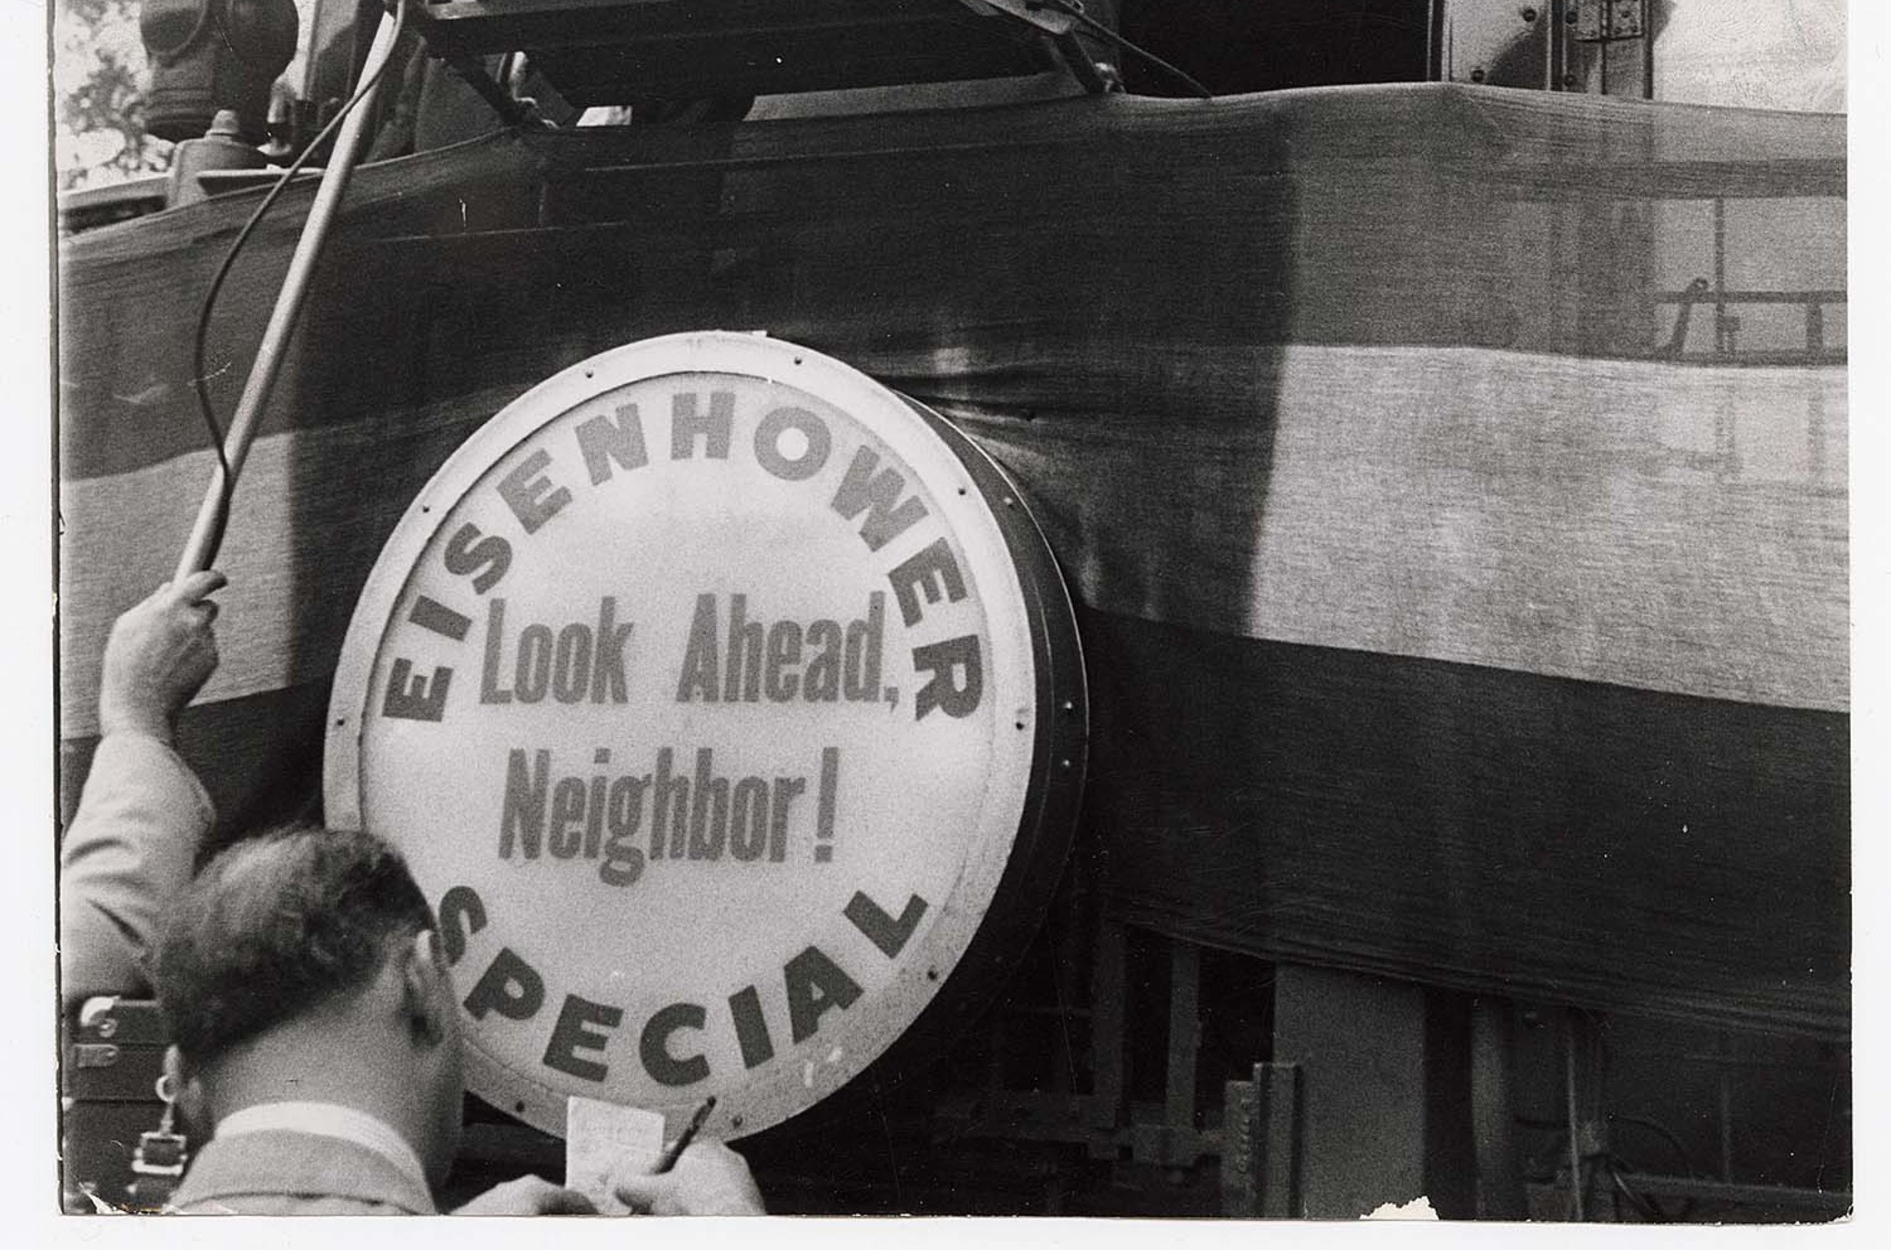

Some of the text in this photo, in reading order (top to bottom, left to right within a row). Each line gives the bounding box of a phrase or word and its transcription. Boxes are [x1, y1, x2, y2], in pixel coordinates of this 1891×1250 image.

[382, 392, 983, 723] EISENHOWER
[480, 591, 899, 712] Look Ahead,
[497, 747, 840, 888] Neighbor!
[438, 885, 929, 1087] SPECIAL
